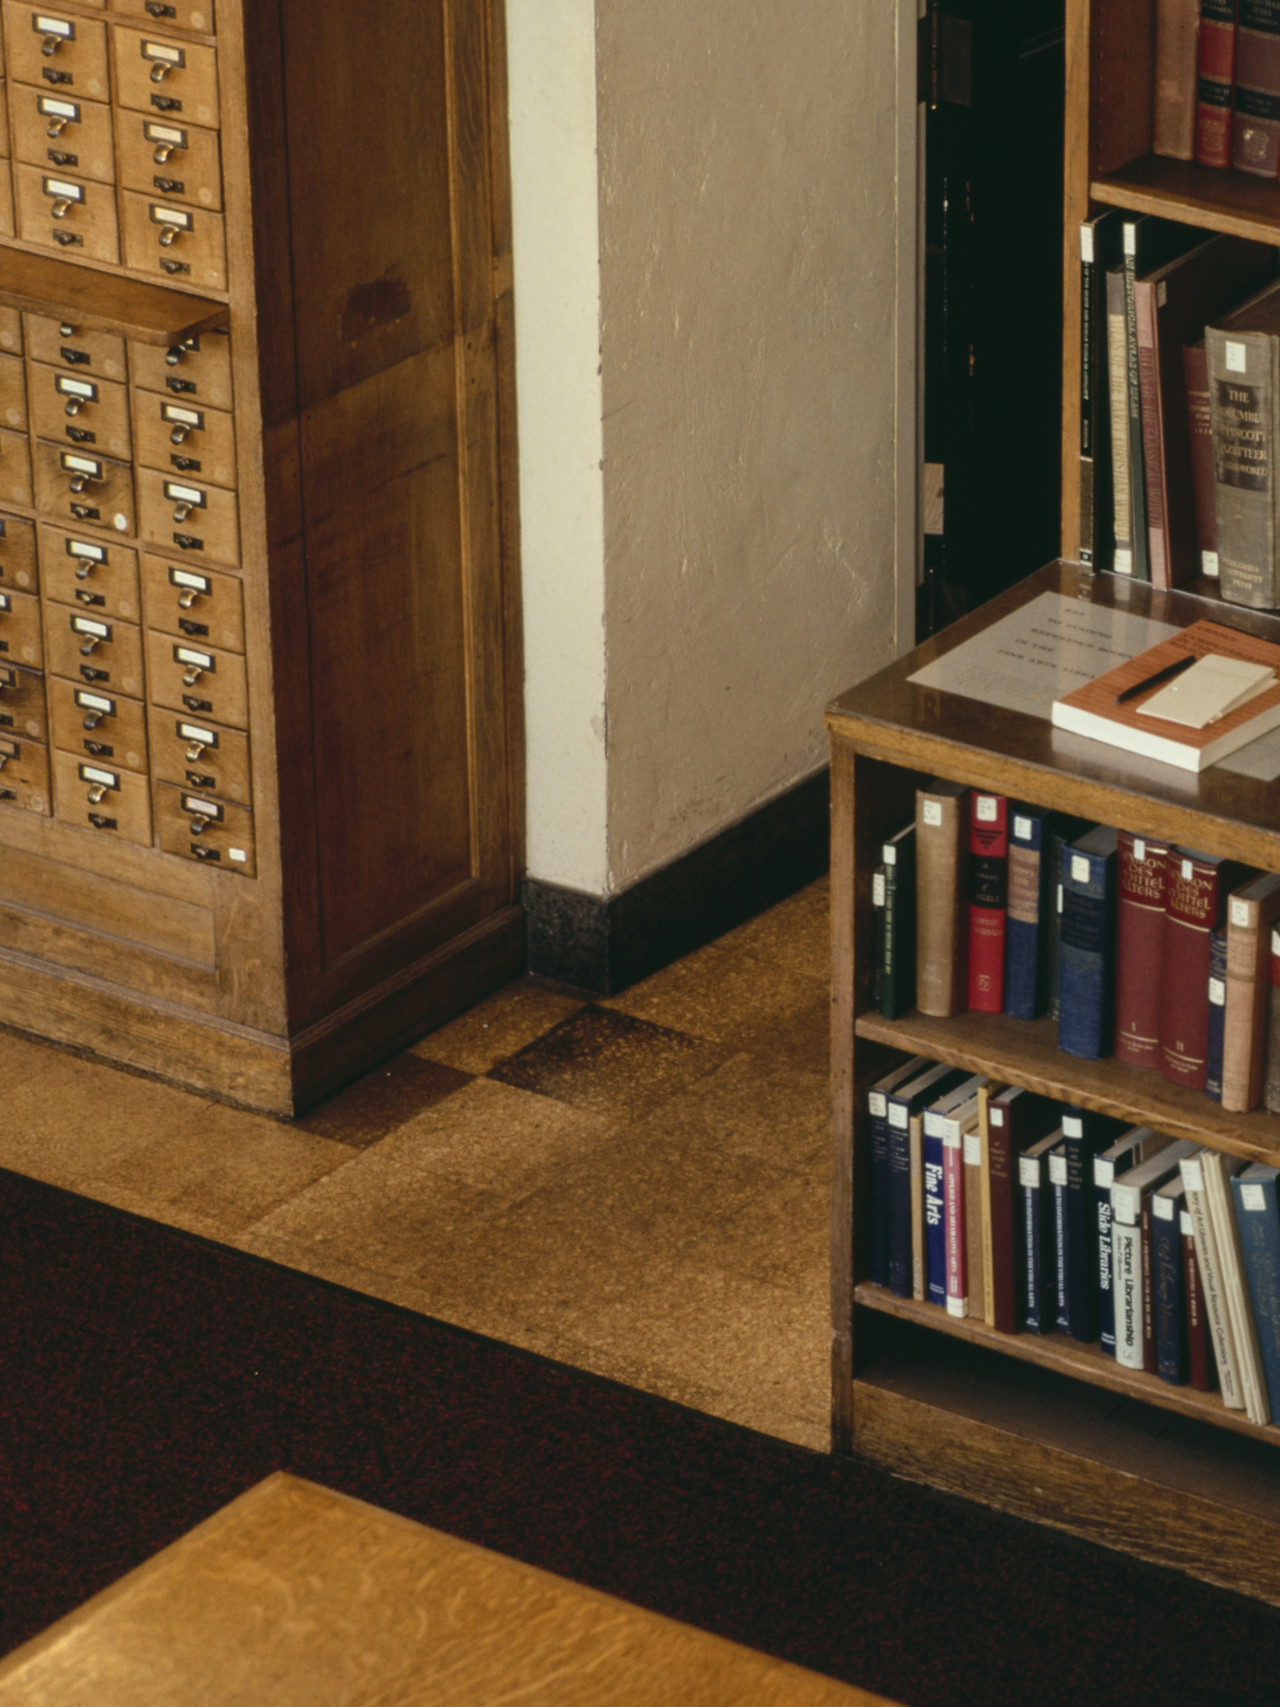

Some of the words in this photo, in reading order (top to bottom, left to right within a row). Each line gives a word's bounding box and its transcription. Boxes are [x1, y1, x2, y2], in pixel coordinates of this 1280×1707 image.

[1229, 390, 1249, 403] THE
[925, 1162, 943, 1192] Fine
[926, 1193, 943, 1225] Arts
[1098, 1201, 1110, 1233] Slide
[1124, 1236, 1134, 1275] Picture
[1197, 1228, 1210, 1256] Libraries
[1099, 1235, 1112, 1290] Libraries
[1125, 1279, 1135, 1347] Librarianship
[1208, 1294, 1221, 1326] Resource
[1214, 1327, 1229, 1366] Collections
